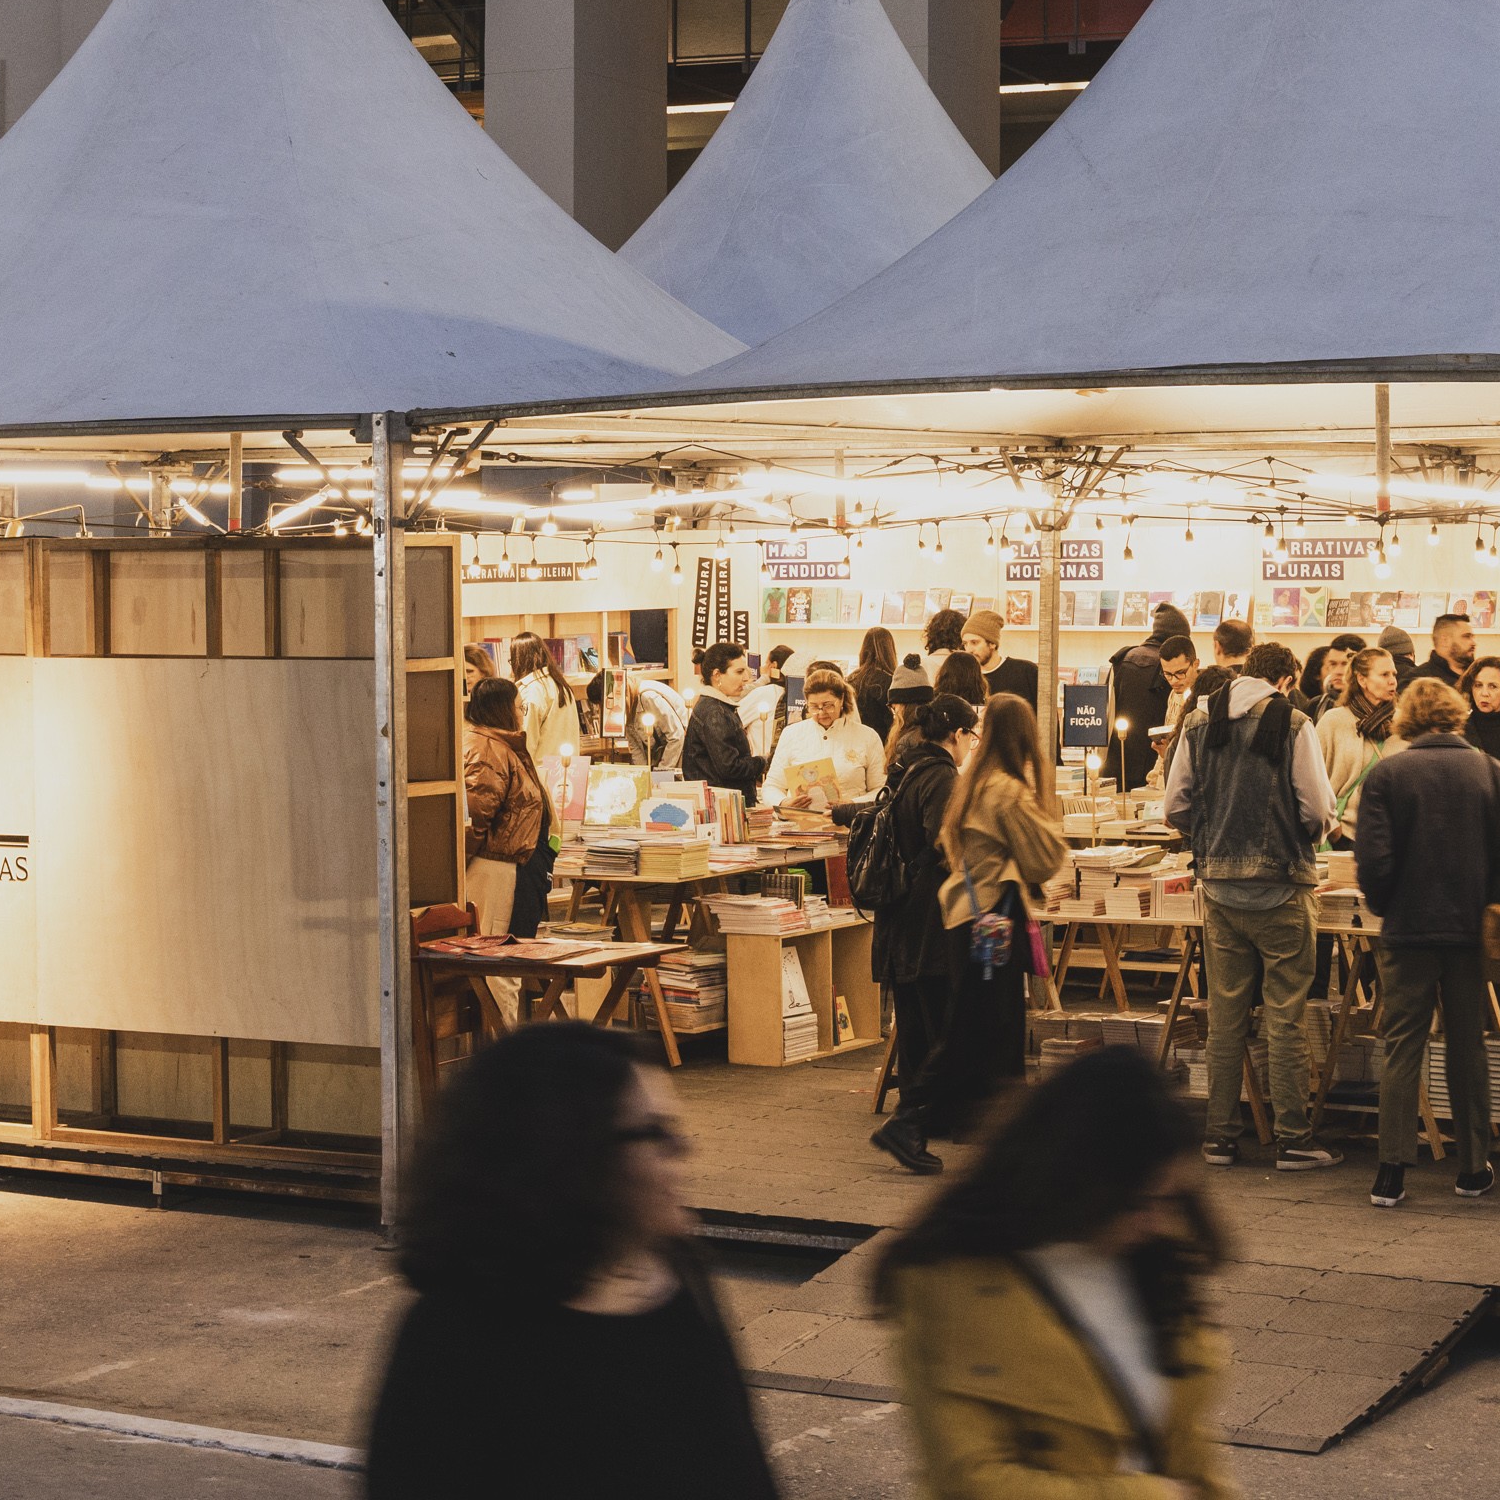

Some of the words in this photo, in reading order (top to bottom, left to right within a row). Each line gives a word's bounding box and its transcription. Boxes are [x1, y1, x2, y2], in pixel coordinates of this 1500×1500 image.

[1009, 542, 1101, 558] CLÁICAS
[769, 563, 848, 579] VENDIDO
[1009, 563, 1101, 579] MODRNAS
[1265, 563, 1342, 578] PLURAIS
[694, 559, 712, 647] LITERATURA
[719, 559, 729, 645] BRASILEIRA
[737, 612, 747, 647] VIVA
[1076, 705, 1096, 715] NÃO
[1070, 716, 1103, 728] FICÇÃO
